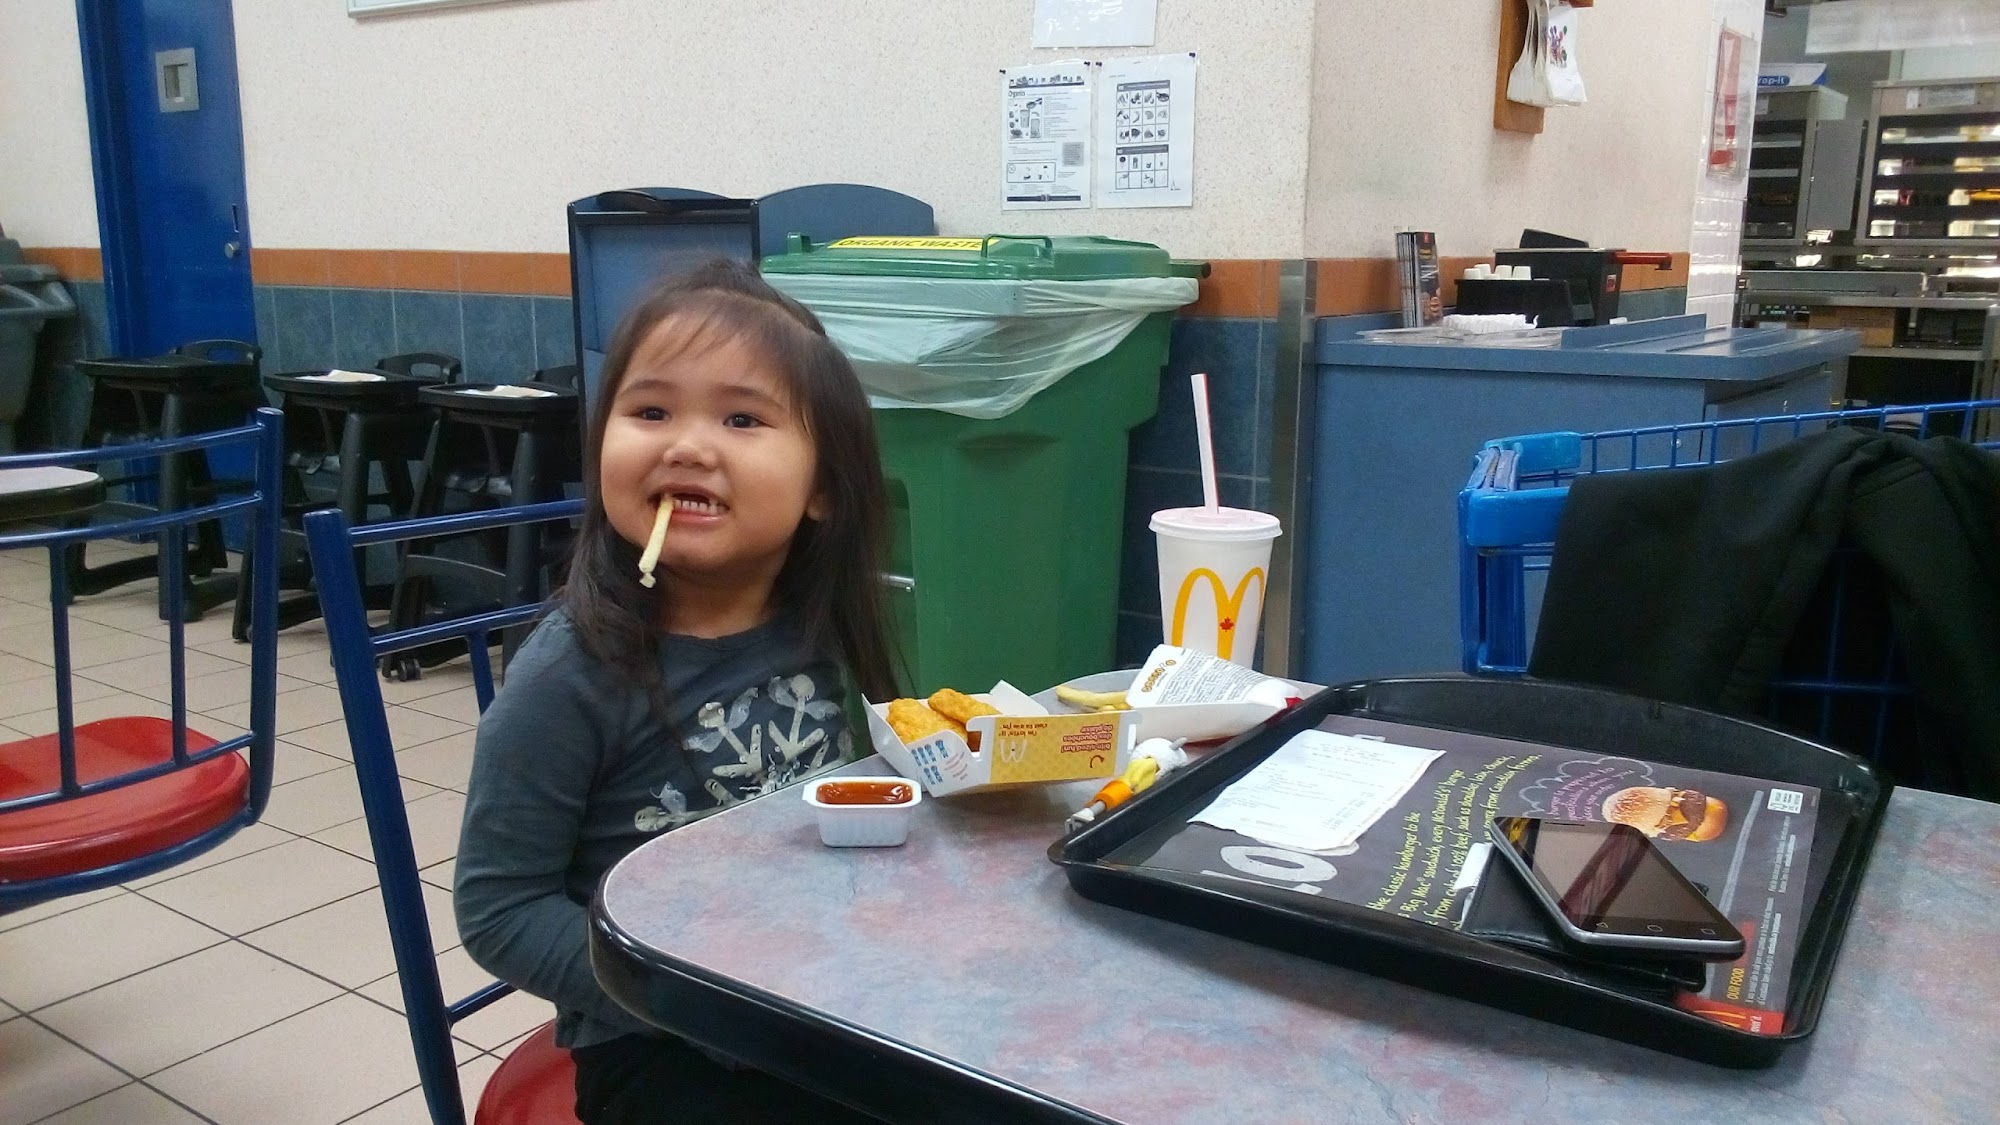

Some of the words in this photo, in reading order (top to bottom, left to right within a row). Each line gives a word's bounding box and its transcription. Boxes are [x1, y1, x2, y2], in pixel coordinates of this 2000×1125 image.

[838, 239, 920, 247] ORGANIC
[920, 240, 982, 249] WASTE
[1479, 793, 1500, 809] from
[1403, 811, 1420, 822] the
[1403, 824, 1418, 832] to
[1393, 833, 1421, 870] hamburger
[1400, 899, 1428, 912] Big
[1432, 824, 1452, 843] every
[1381, 872, 1407, 896] classic
[1423, 898, 1454, 920] from
[1726, 985, 1741, 1000] OUR
